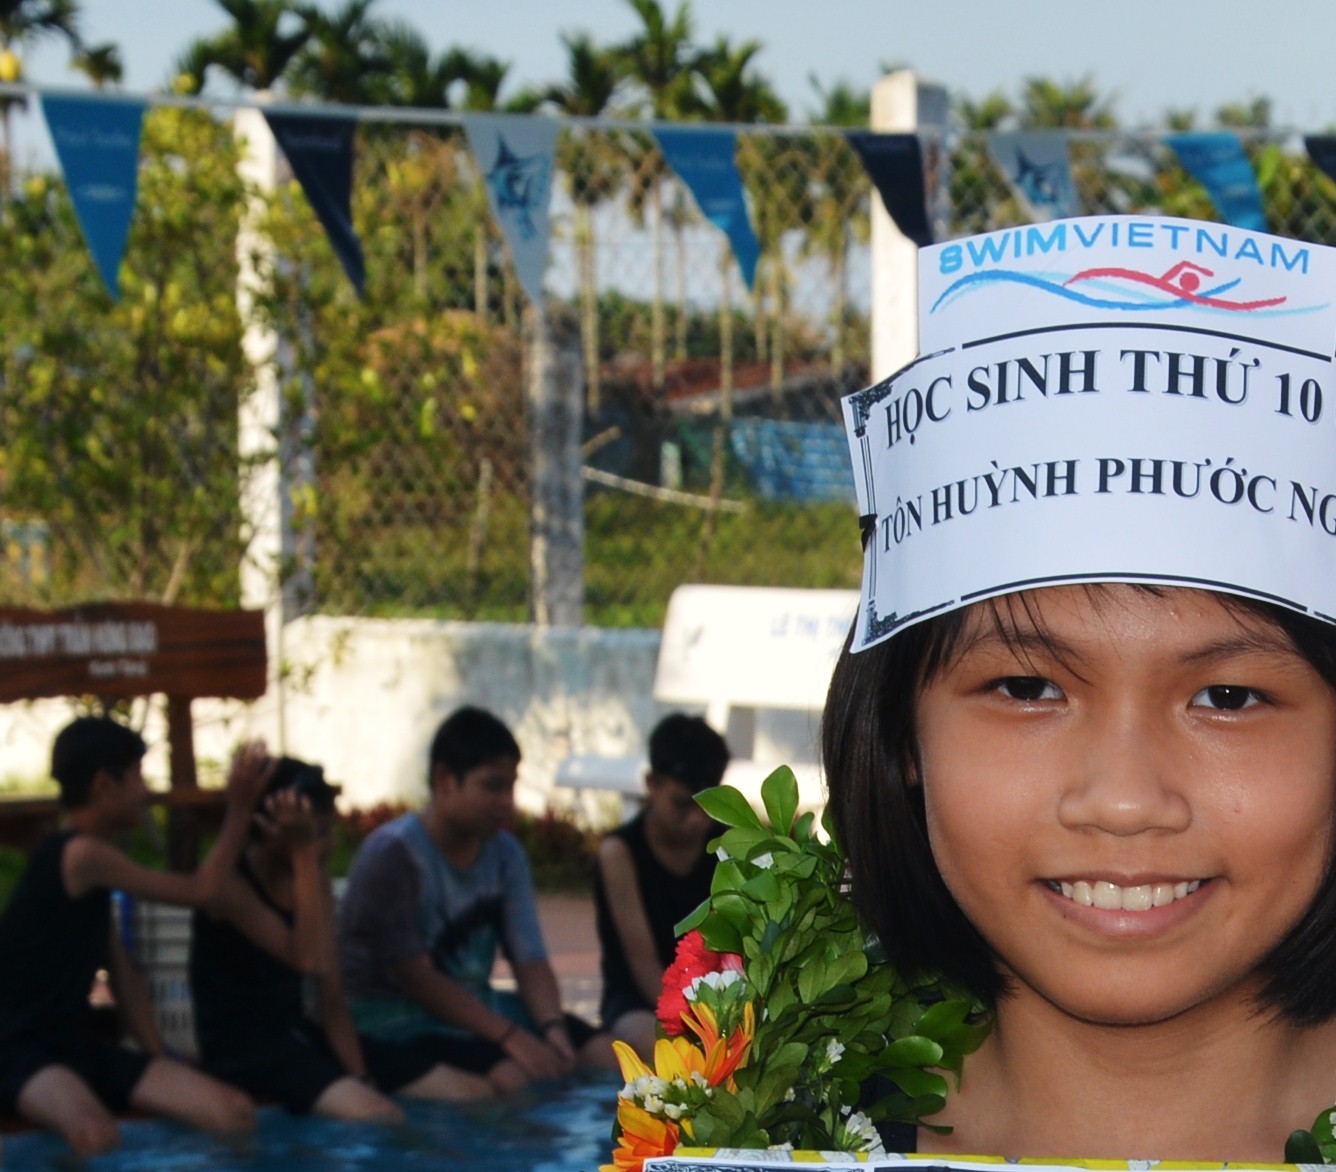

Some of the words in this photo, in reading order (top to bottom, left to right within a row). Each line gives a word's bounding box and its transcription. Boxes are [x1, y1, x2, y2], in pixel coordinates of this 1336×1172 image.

[881, 376, 953, 449] HỌC
[966, 349, 1099, 412] SINH
[1119, 347, 1260, 405] THỨ
[1276, 373, 1324, 424] 10
[881, 499, 923, 553] TÔN
[931, 460, 1077, 525] HUỲNH
[1097, 457, 1277, 513] PHƯỚC
